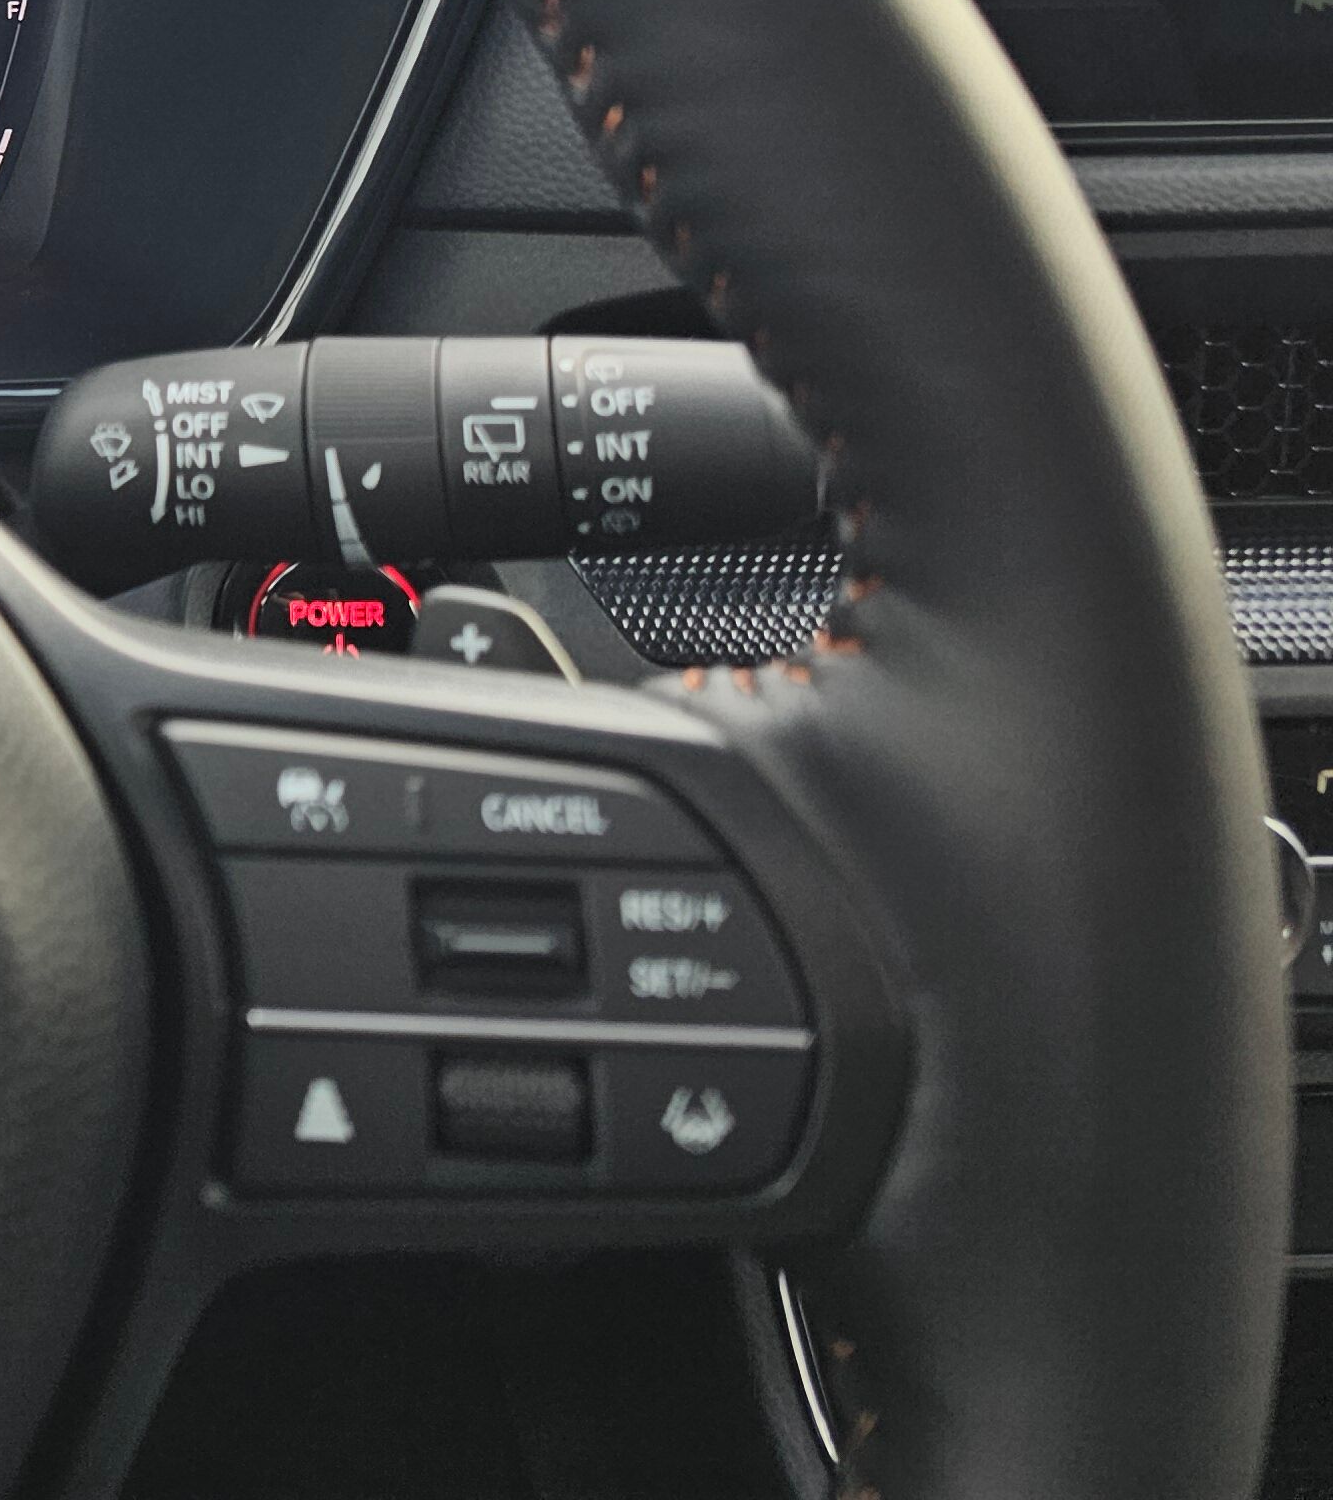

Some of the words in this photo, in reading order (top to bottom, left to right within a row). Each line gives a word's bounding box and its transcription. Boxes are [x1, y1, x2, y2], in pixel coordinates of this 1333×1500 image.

[7, 1, 20, 20] F
[167, 381, 234, 405] MIST
[590, 387, 656, 417] OFF
[172, 412, 228, 439] OFF
[176, 442, 224, 470] INT
[595, 431, 652, 463] INT
[463, 461, 531, 485] REAR
[176, 475, 215, 500] LO
[600, 476, 654, 504] ON
[290, 601, 385, 628] POWER
[481, 793, 610, 836] CANCEL
